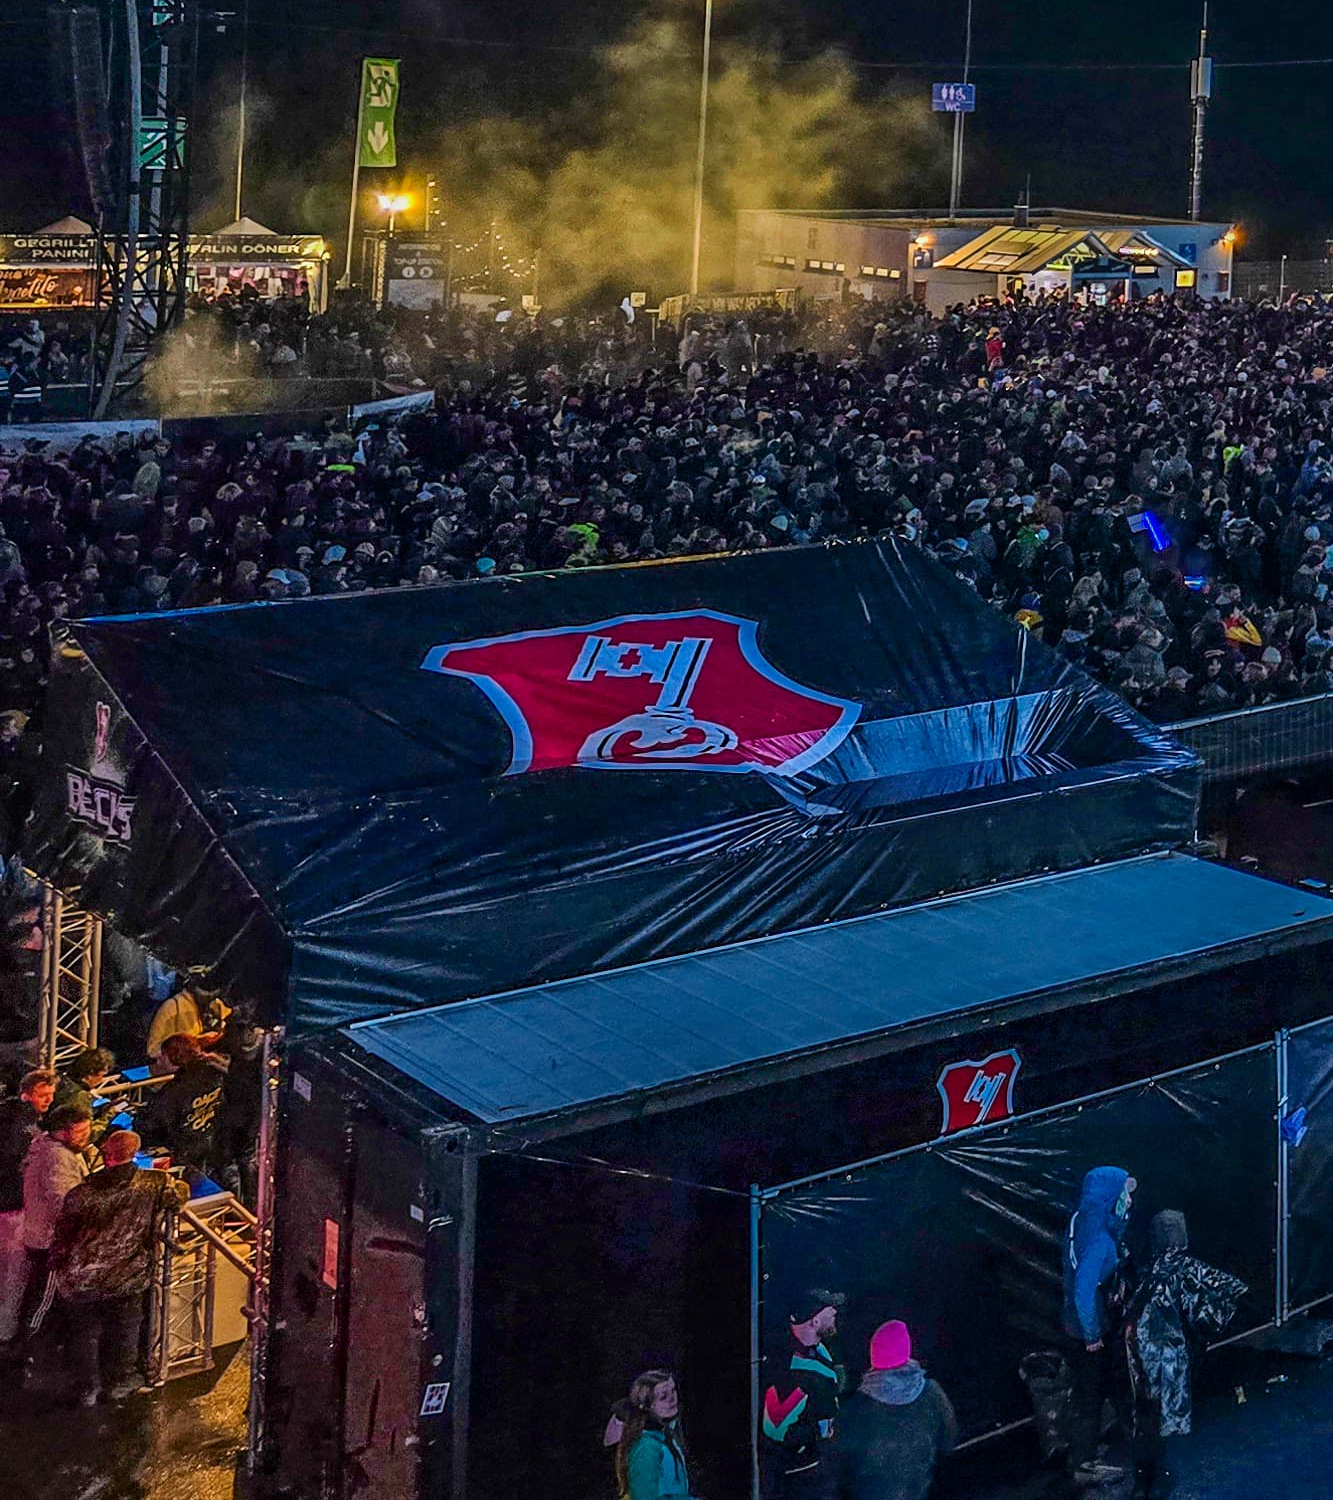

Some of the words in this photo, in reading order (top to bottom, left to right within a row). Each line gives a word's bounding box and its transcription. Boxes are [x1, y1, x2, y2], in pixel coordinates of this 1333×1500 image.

[944, 100, 961, 112] WC
[32, 249, 89, 258] PANINI
[185, 244, 237, 254] ERLIN
[241, 243, 300, 254] DÖNER
